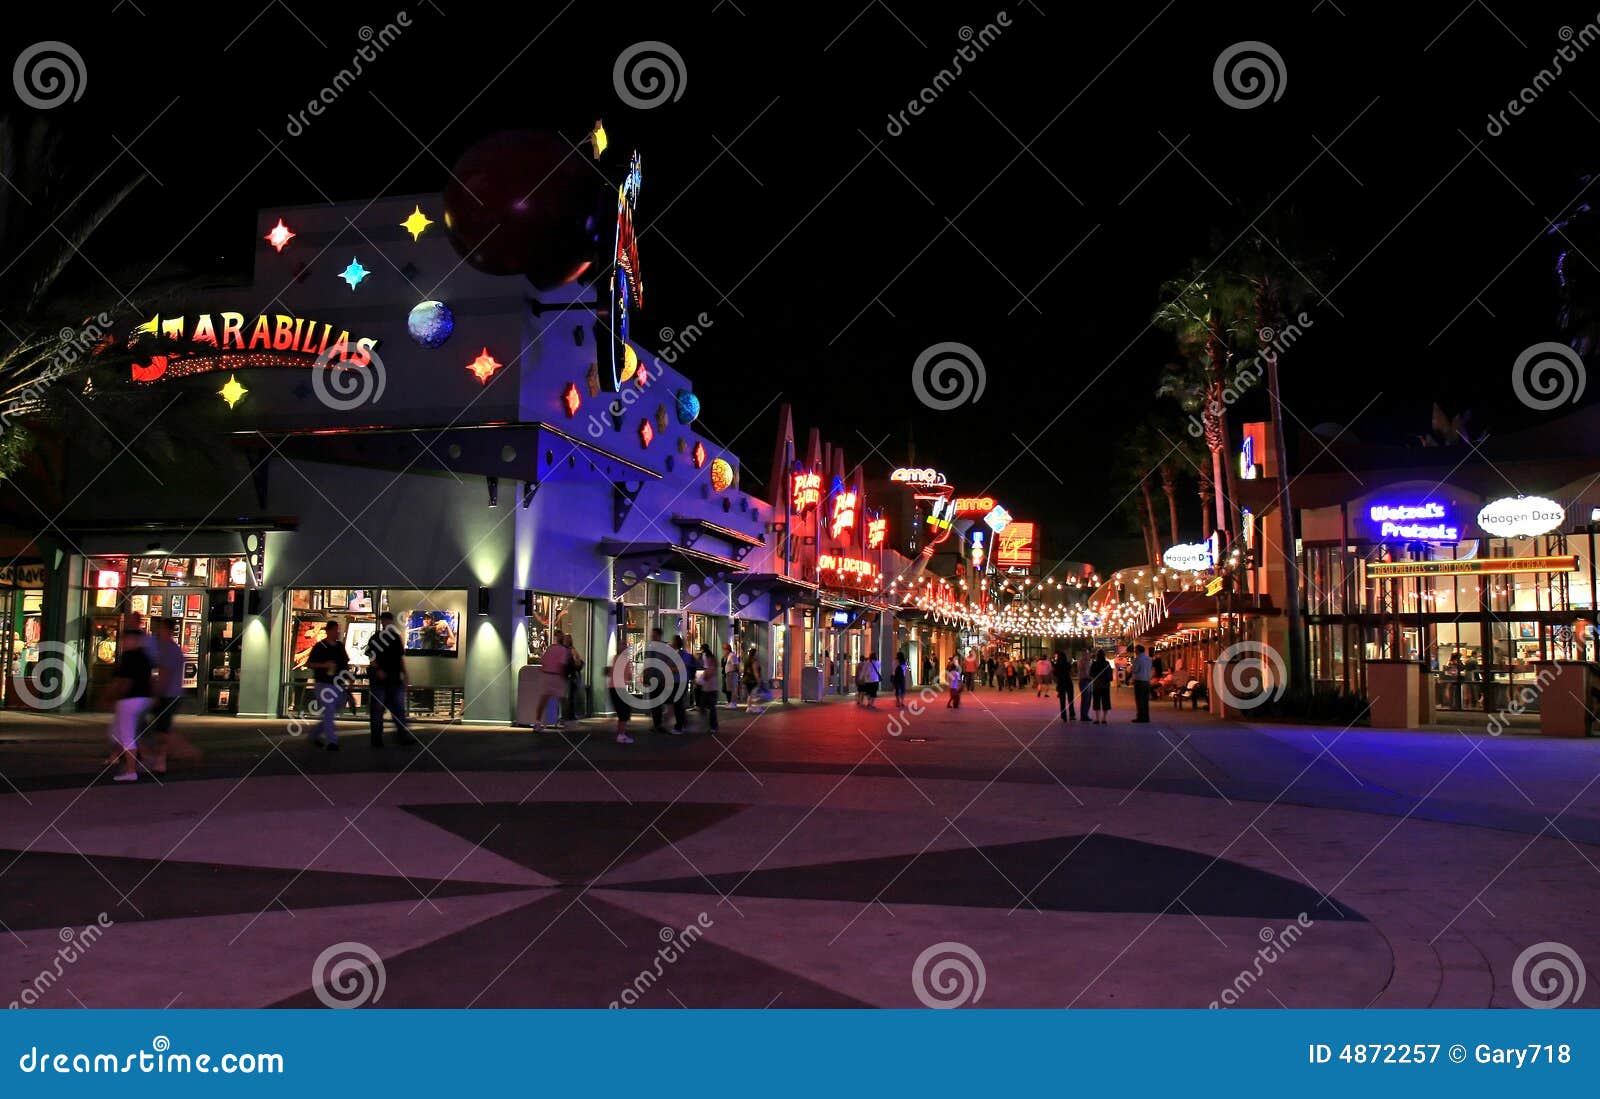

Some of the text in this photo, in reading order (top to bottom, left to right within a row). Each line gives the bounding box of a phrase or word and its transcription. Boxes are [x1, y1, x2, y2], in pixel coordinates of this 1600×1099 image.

[1370, 502, 1445, 521] Wetzel's
[1532, 510, 1562, 521] Dazs
[1381, 521, 1457, 540] Pretzels
[819, 555, 836, 570] ON
[1374, 566, 1396, 575] FRESH
[1396, 564, 1426, 574] PRETZELS
[1438, 562, 1451, 572] HOT
[1454, 562, 1473, 571] DOGS
[1521, 559, 1547, 569] CREAM
